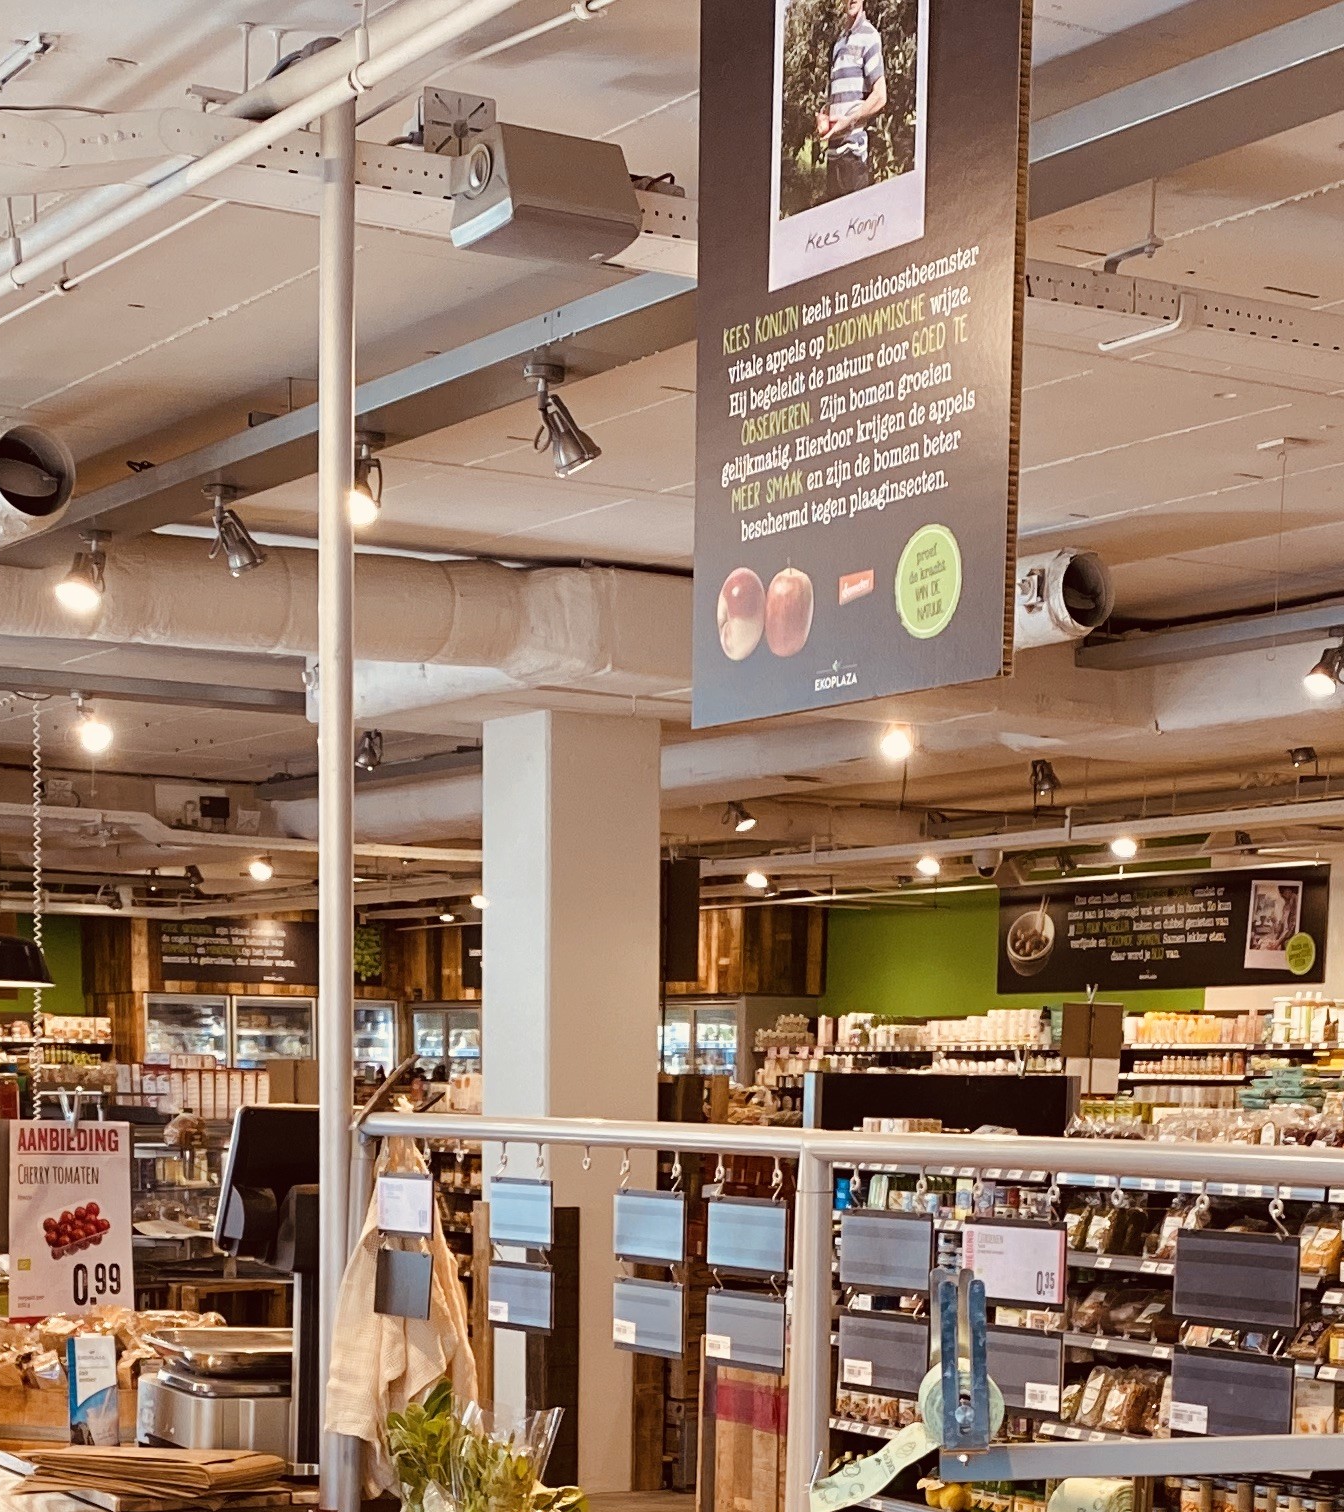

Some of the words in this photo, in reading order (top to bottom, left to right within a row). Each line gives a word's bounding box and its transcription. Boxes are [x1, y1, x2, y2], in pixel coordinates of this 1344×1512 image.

[805, 231, 840, 252] Kees
[847, 213, 886, 241] Konijn
[723, 324, 750, 355] KEES
[755, 305, 799, 345] KONIJN
[802, 296, 831, 326] teelt
[835, 292, 848, 315] in
[851, 245, 979, 309] Zuidoostbeemster
[728, 357, 764, 384] vitale
[766, 340, 806, 371] appels
[809, 335, 825, 361] op
[827, 293, 926, 352] BIODYNAMISCHE
[930, 285, 971, 316] wijze.
[729, 391, 748, 418] Hij
[750, 372, 806, 411] begeleidt
[808, 367, 824, 390] de
[826, 352, 874, 385] natuur
[877, 340, 910, 369] door
[912, 321, 946, 358] GOED
[953, 314, 968, 344] TE
[741, 401, 813, 446] OBSERVEREN.
[819, 392, 846, 423] Zijn
[849, 382, 895, 410] bomen
[898, 361, 952, 401] groeien
[722, 443, 792, 487] gelijkmatig.
[795, 427, 853, 461] Hierdoor
[856, 414, 905, 444] krijgen
[908, 404, 925, 426] de
[928, 388, 976, 425] appels
[731, 481, 760, 514] MEER
[766, 470, 803, 504] SMAAK
[807, 472, 823, 490] en
[826, 458, 851, 489] zijn
[854, 453, 870, 476] de
[873, 441, 919, 469] bomen
[922, 430, 962, 458] beter
[741, 502, 808, 542] beschermd
[811, 498, 846, 525] tegen
[849, 469, 949, 518] plaaginsecten.
[814, 672, 857, 691] EKOPLAZA
[18, 1128, 119, 1152] AANBIEDING
[18, 1164, 49, 1185] CHERRY
[53, 1166, 99, 1185] TOMATEN
[73, 1263, 121, 1306] 0.99
